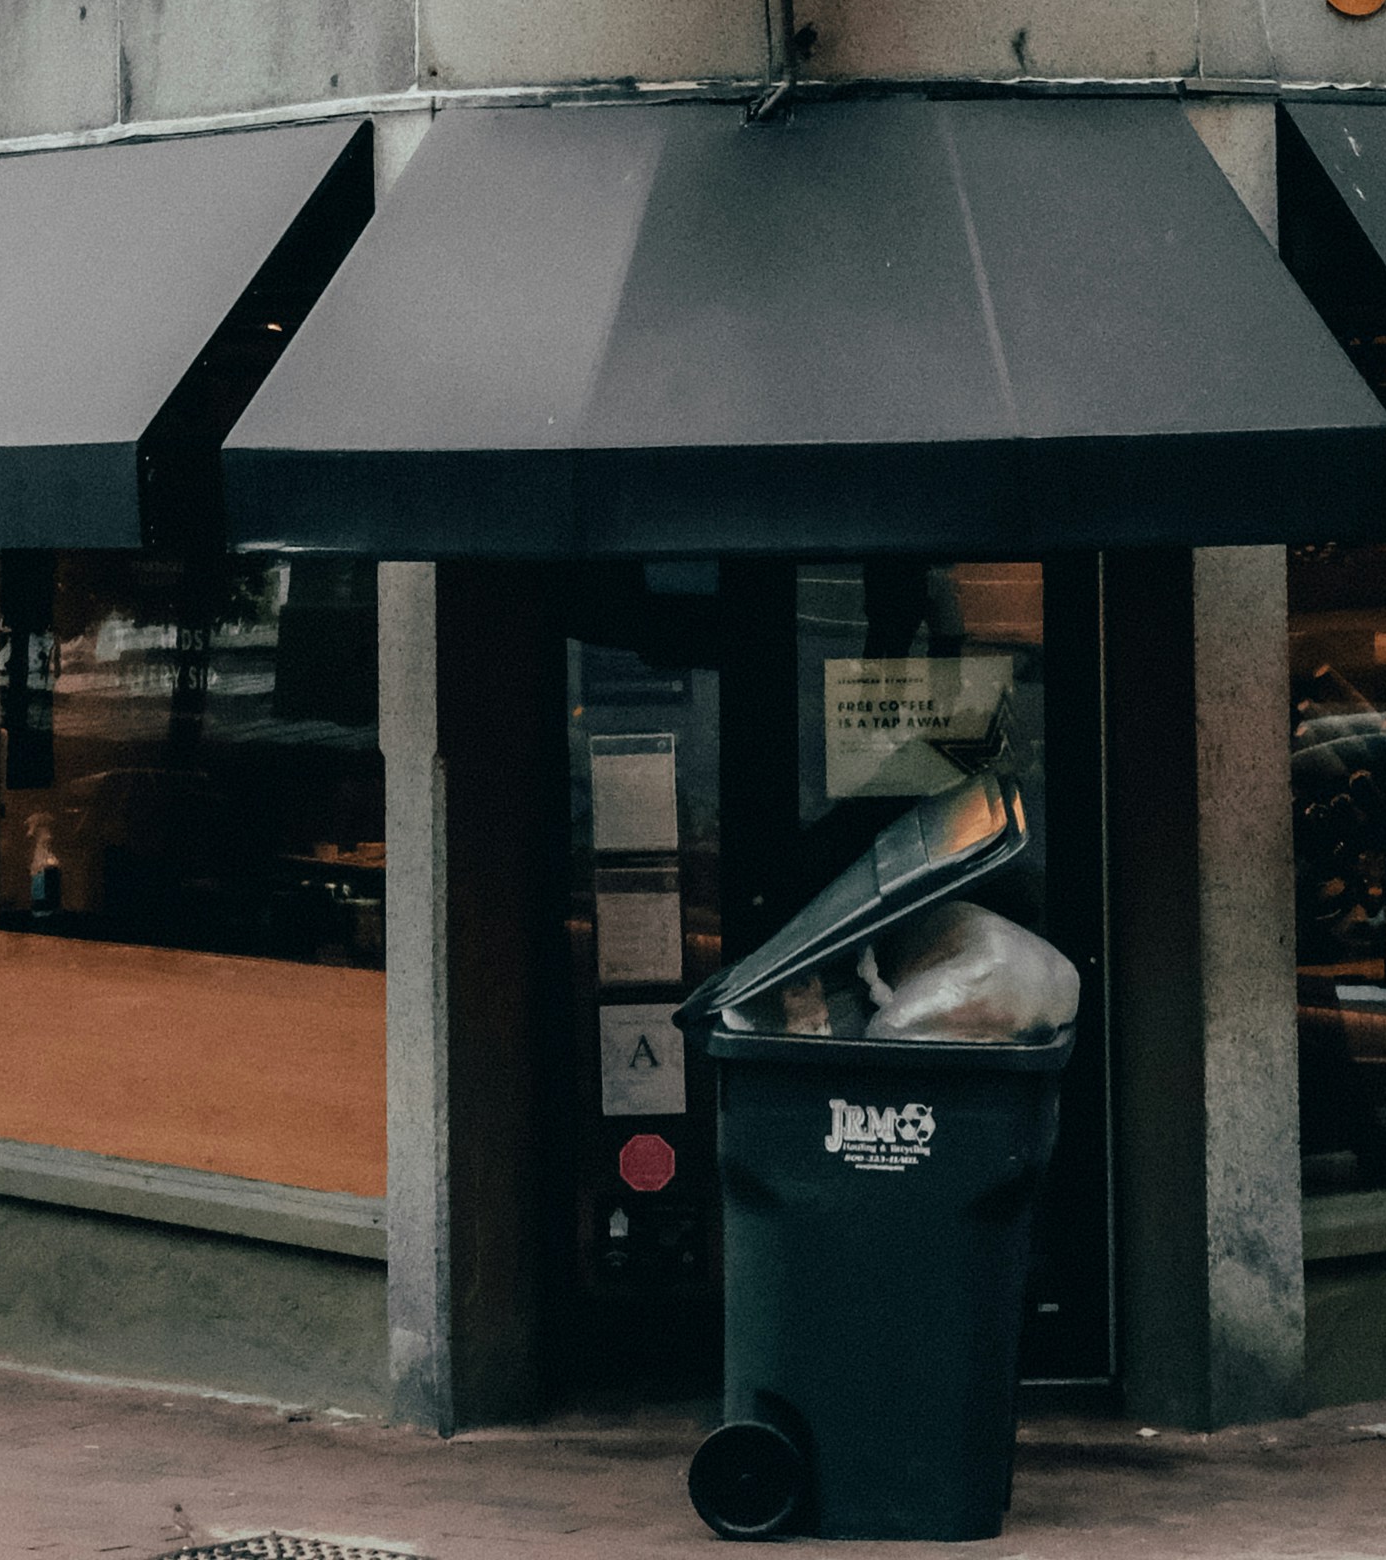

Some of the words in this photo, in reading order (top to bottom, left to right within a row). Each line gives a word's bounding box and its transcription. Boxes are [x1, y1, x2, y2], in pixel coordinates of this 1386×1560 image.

[837, 700, 872, 712] FREE
[879, 700, 934, 712] COFFEE
[838, 718, 852, 729] IS
[857, 718, 867, 729] A
[873, 717, 900, 729] TAP
[906, 717, 951, 728] AWAY
[629, 1034, 661, 1068] A
